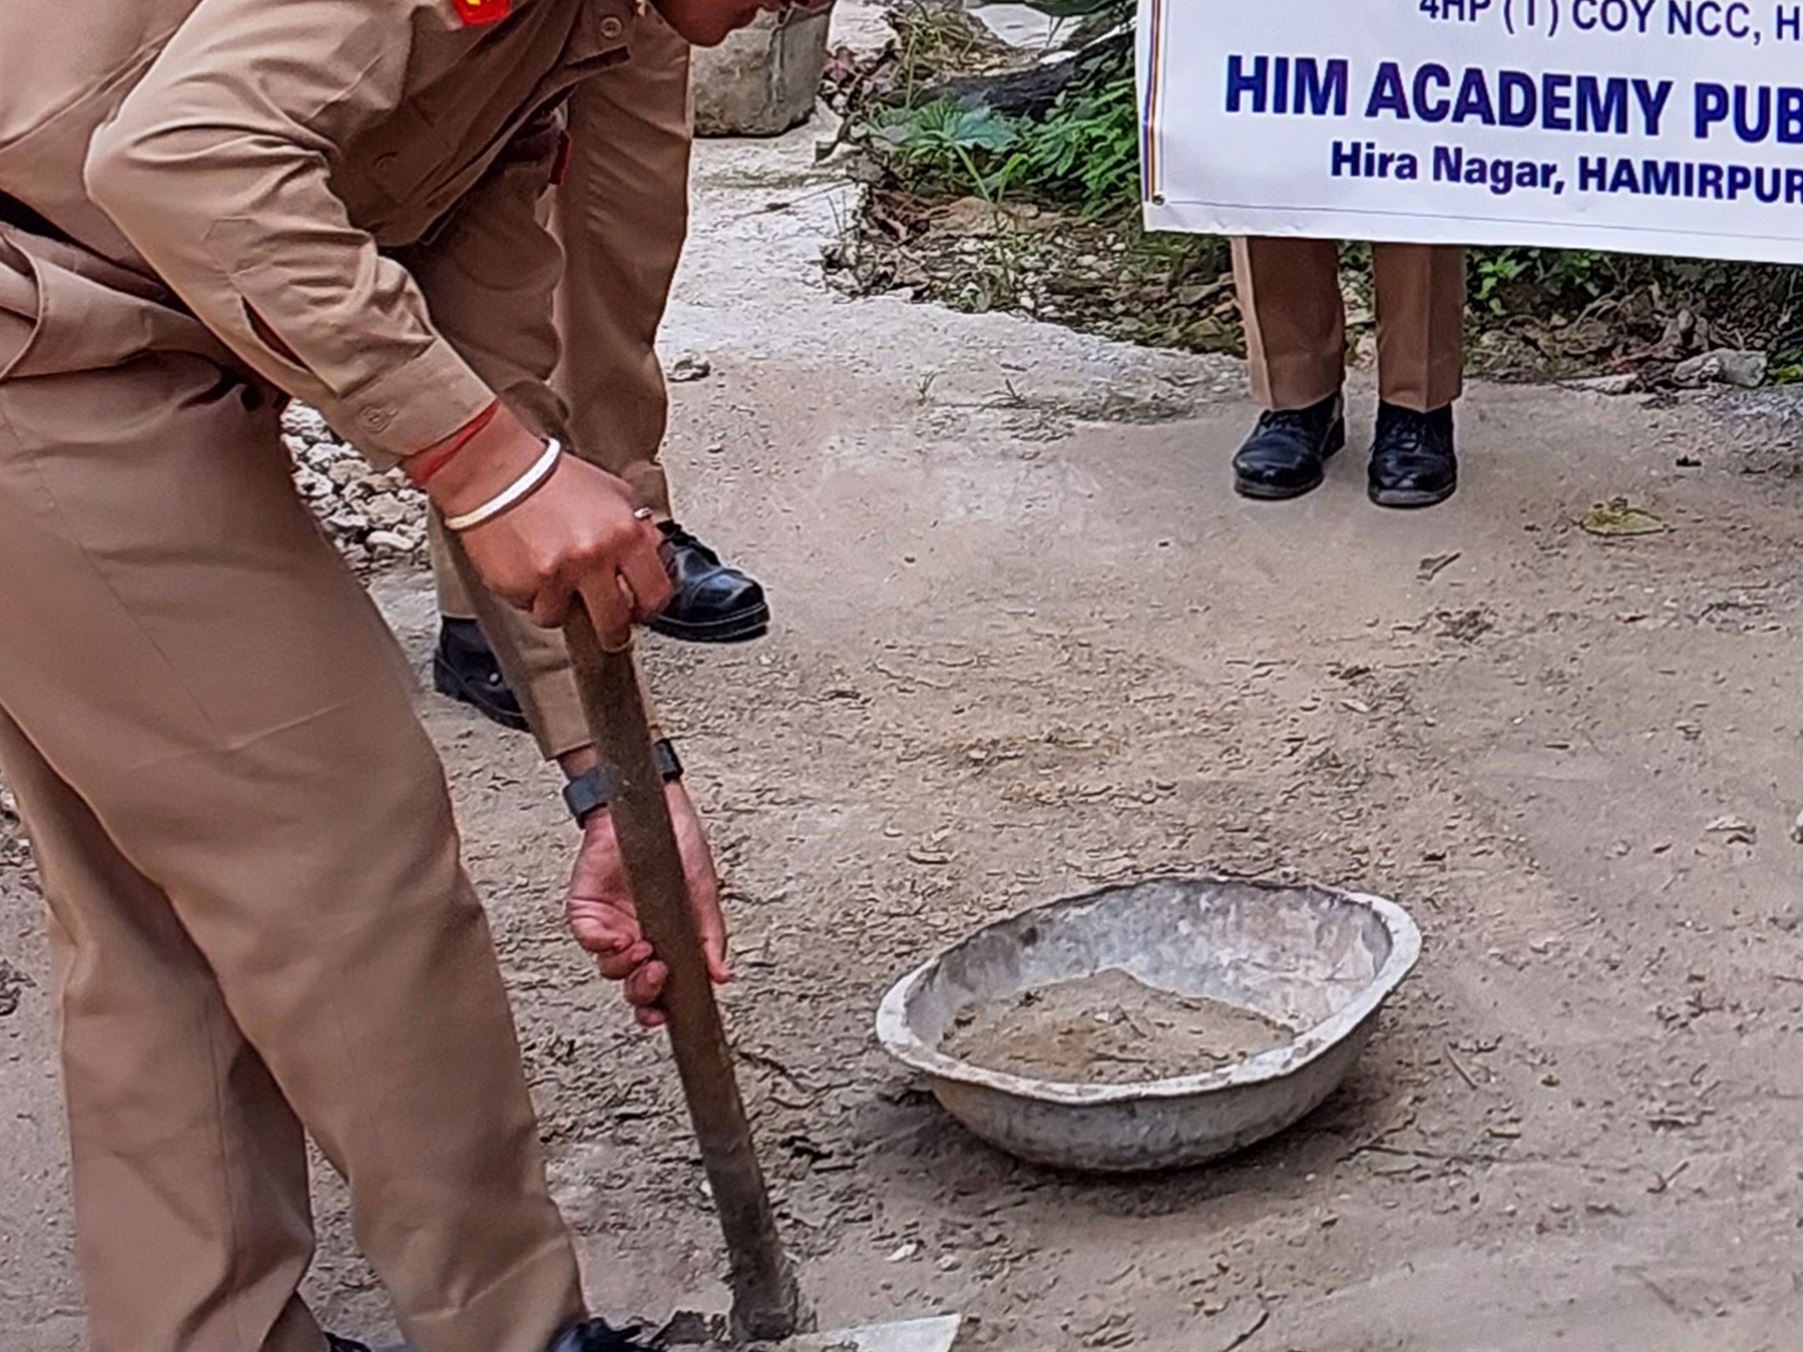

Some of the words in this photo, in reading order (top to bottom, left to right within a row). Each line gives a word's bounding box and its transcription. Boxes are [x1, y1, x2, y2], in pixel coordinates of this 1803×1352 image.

[1225, 54, 1350, 117] HIM
[1364, 61, 1674, 137] ACADEMY
[1331, 140, 1419, 180] Hira
[1432, 145, 1566, 197] Nagar,
